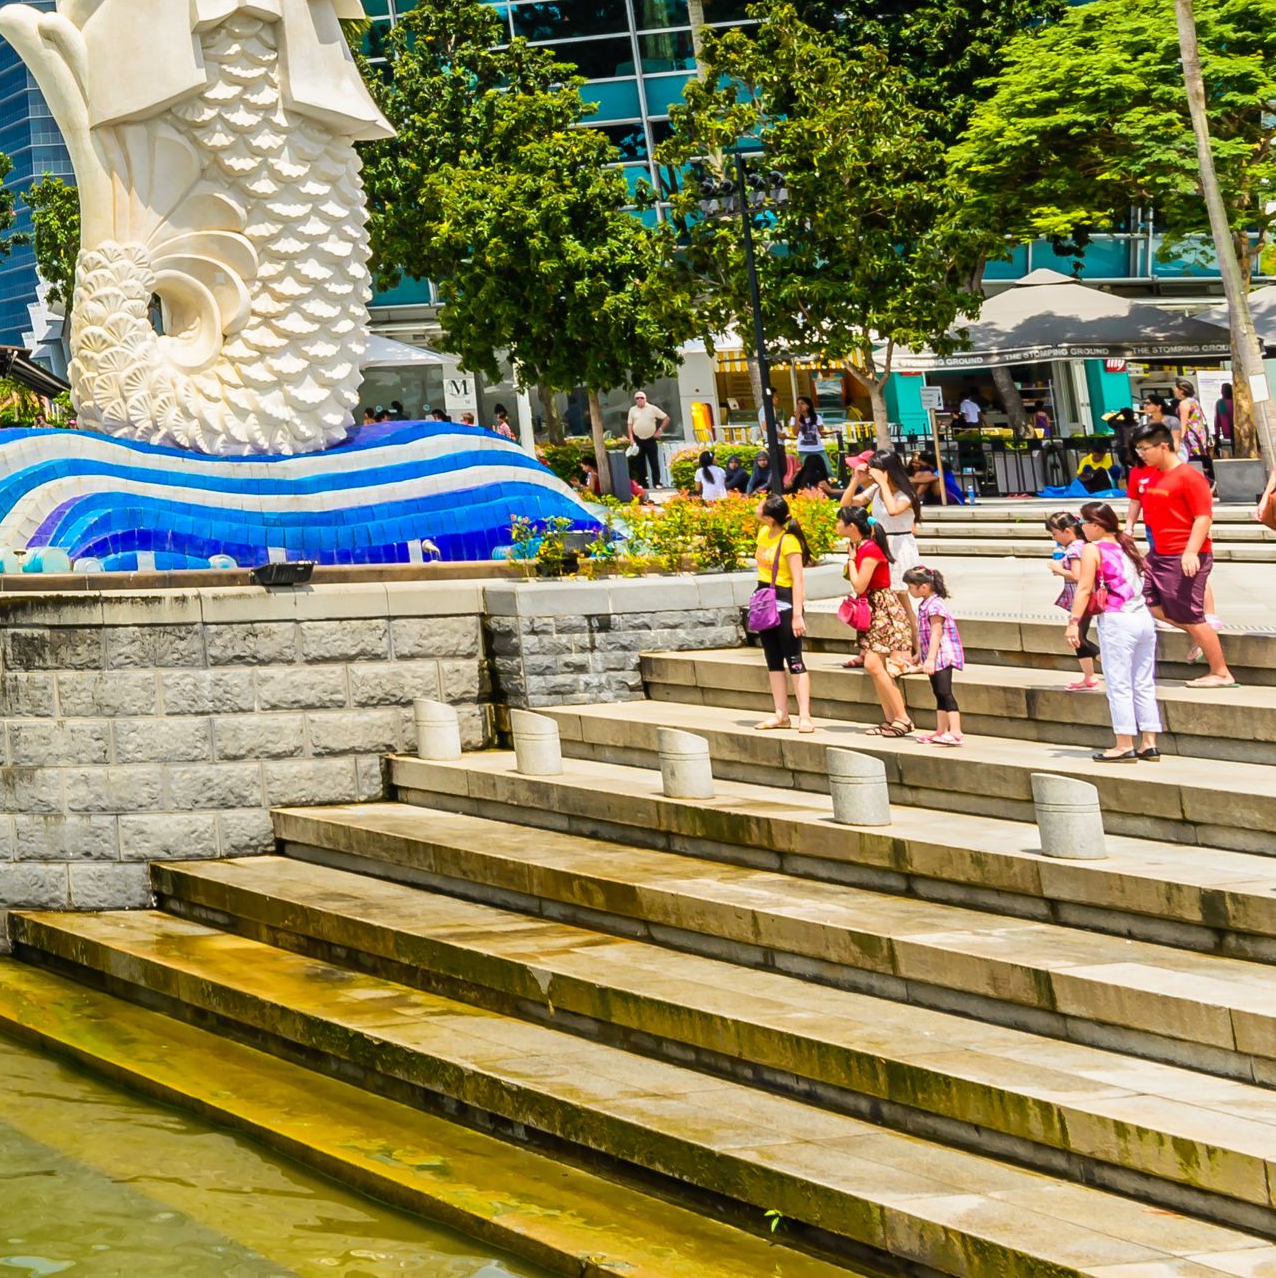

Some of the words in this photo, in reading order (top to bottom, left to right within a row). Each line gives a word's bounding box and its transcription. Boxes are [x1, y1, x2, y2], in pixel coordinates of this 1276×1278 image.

[1004, 353, 1022, 361] THE
[1023, 347, 1069, 359] STOMPING
[1070, 347, 1110, 356] GROUND
[1131, 346, 1150, 355] THE
[1152, 345, 1200, 354] STOMPING
[1202, 343, 1232, 353] GROU
[946, 356, 984, 366] GROUND
